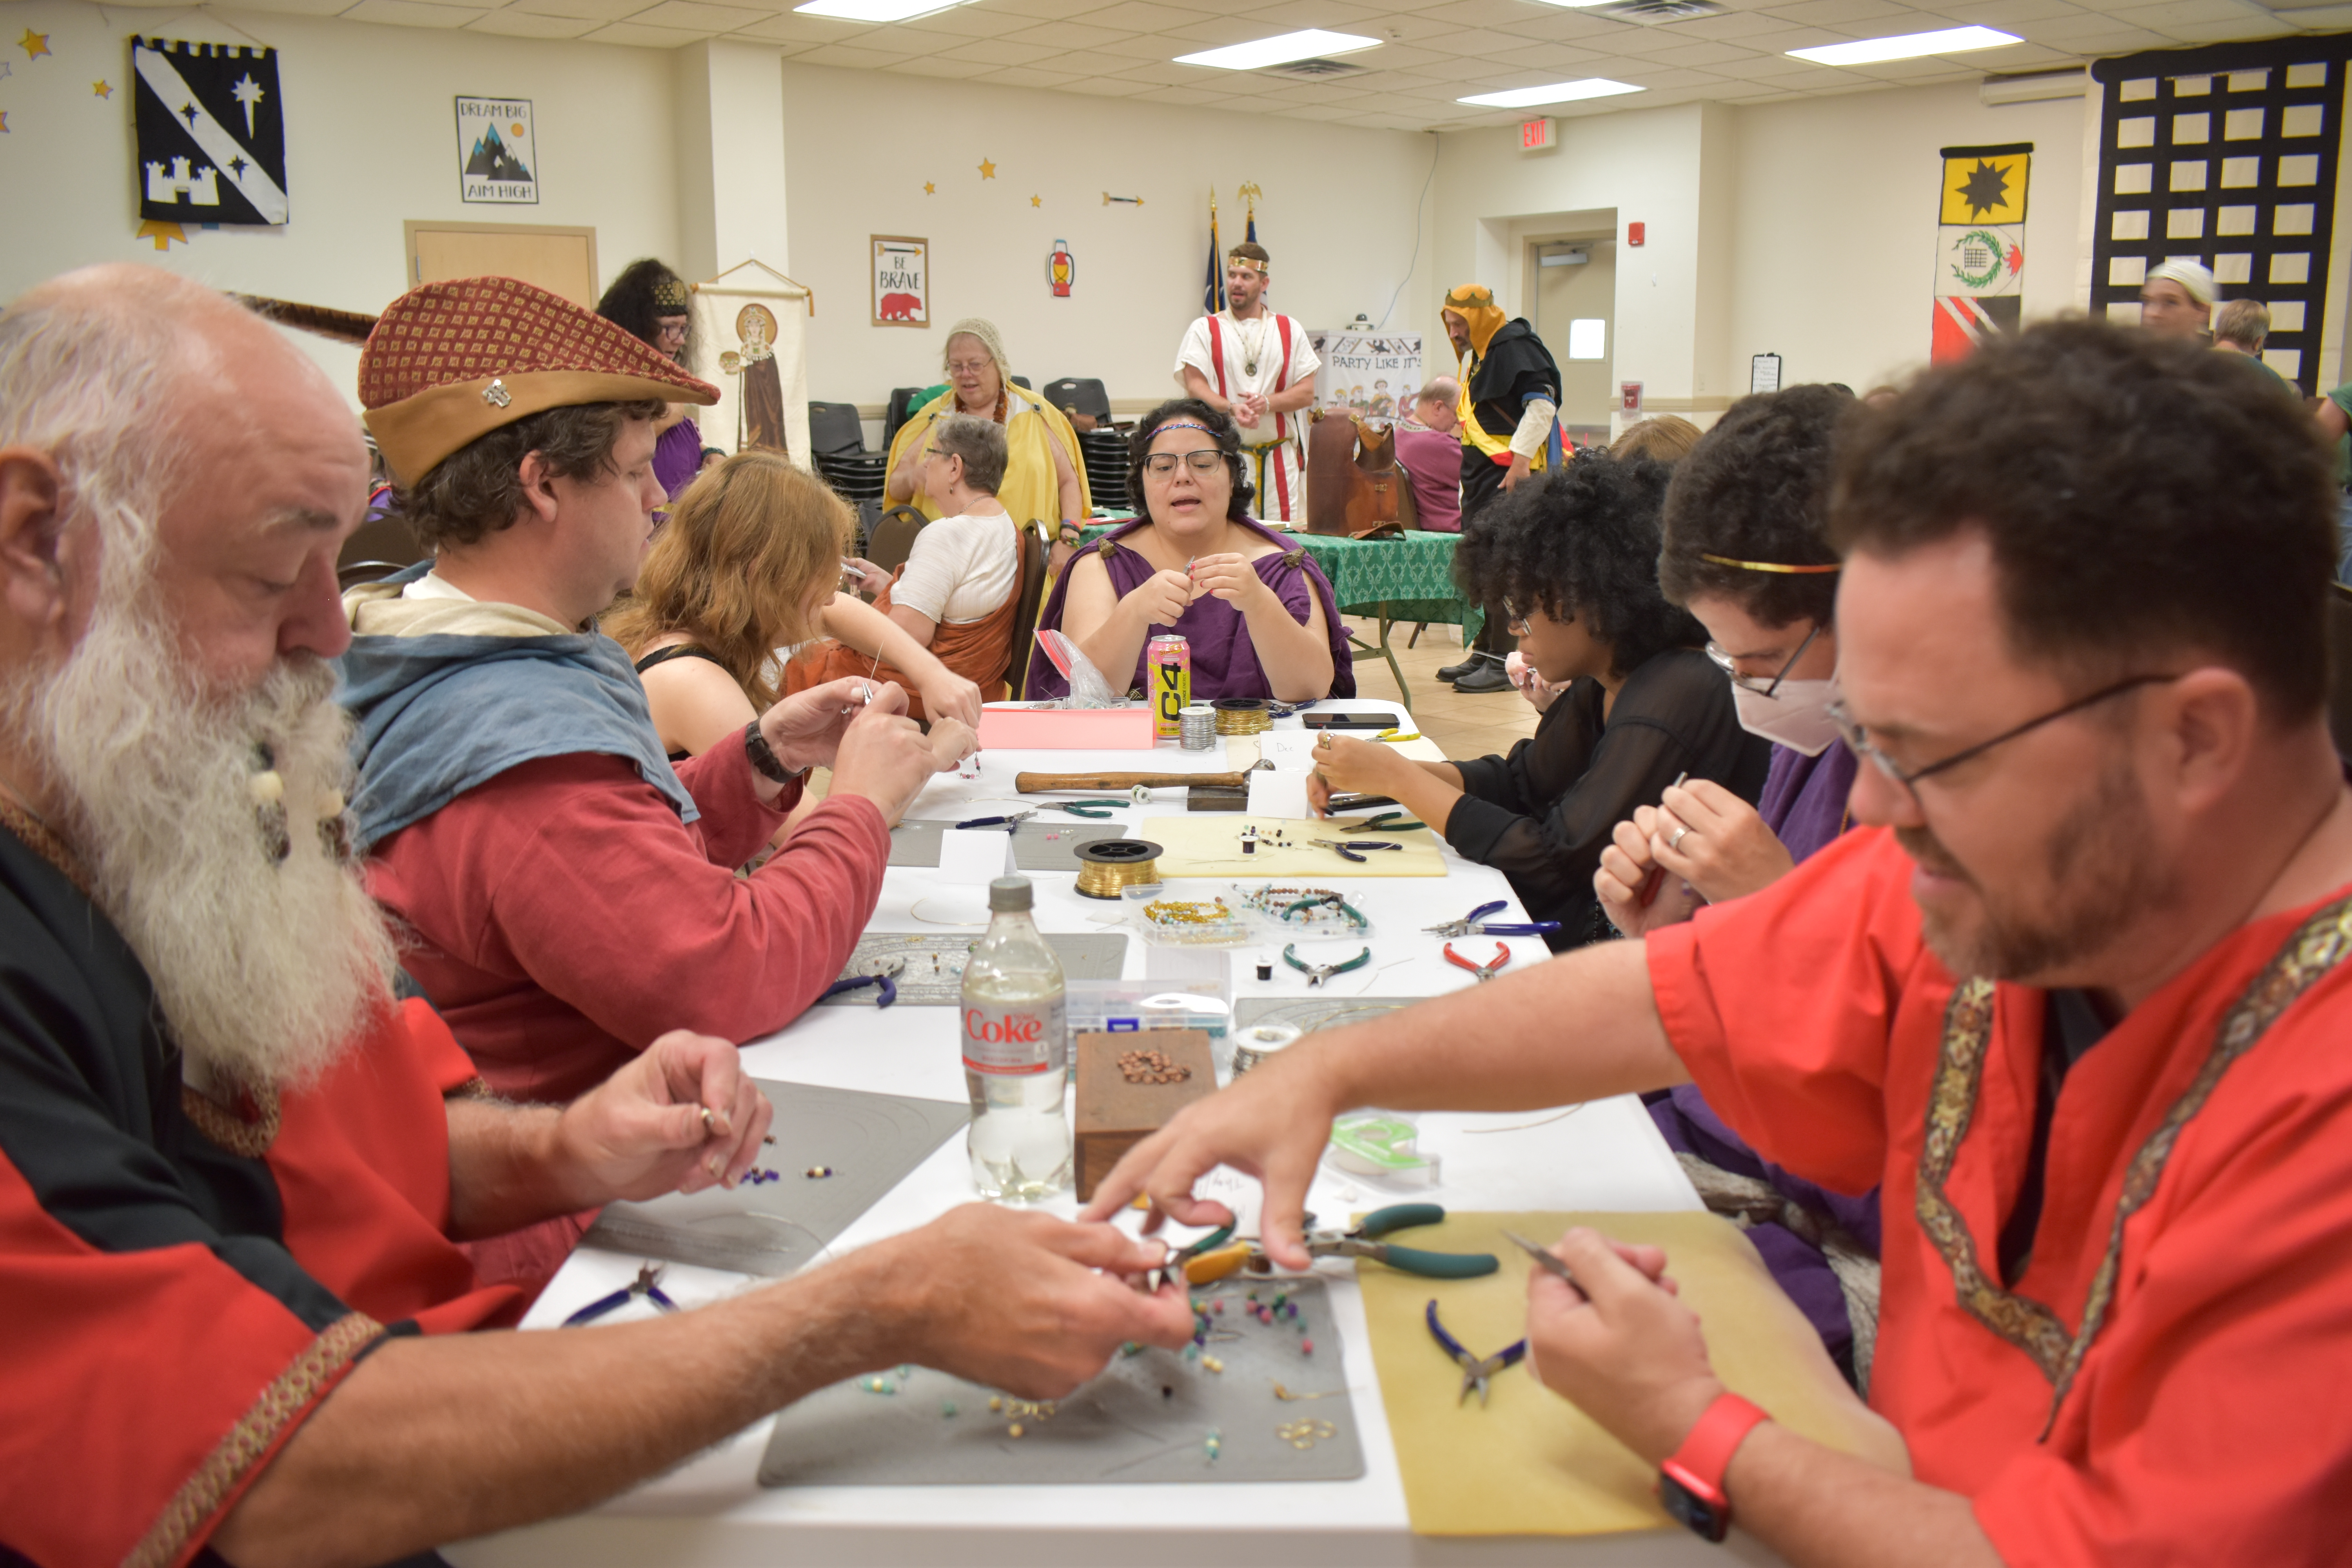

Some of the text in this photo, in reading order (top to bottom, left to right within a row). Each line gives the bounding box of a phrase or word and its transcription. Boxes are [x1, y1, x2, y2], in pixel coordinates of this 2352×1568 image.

[461, 103, 526, 118] DREAM BIG
[1524, 120, 1546, 147] EXIT
[468, 185, 531, 198] AIM HIGH
[895, 256, 906, 269] BE
[880, 270, 920, 290] BRAVE
[1333, 356, 1371, 370] PARTY
[1376, 357, 1399, 369] LIKE
[1161, 662, 1181, 721] C4
[966, 1009, 1042, 1044] Coke
